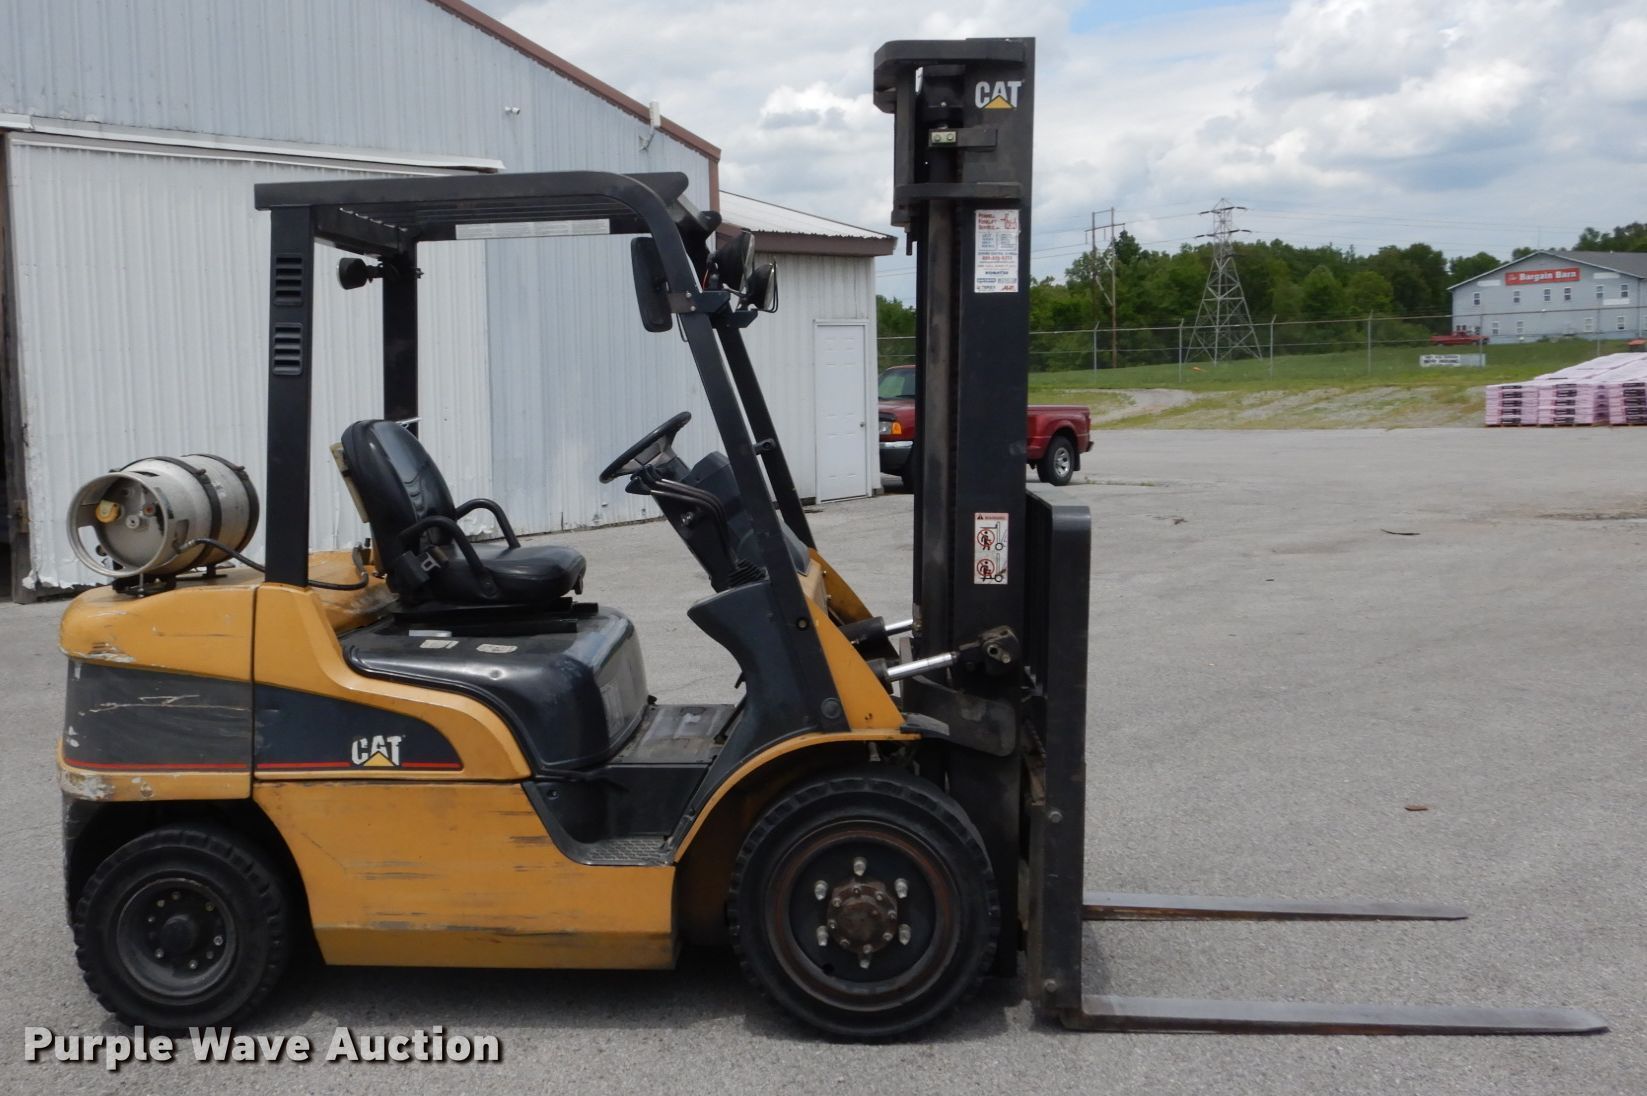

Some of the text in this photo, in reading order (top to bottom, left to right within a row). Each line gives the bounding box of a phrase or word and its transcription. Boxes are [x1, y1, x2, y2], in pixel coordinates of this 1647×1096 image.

[975, 81, 1022, 109] CAT
[1519, 272, 1553, 282] Bargain
[1555, 270, 1577, 279] Barn
[352, 735, 402, 766] CAT
